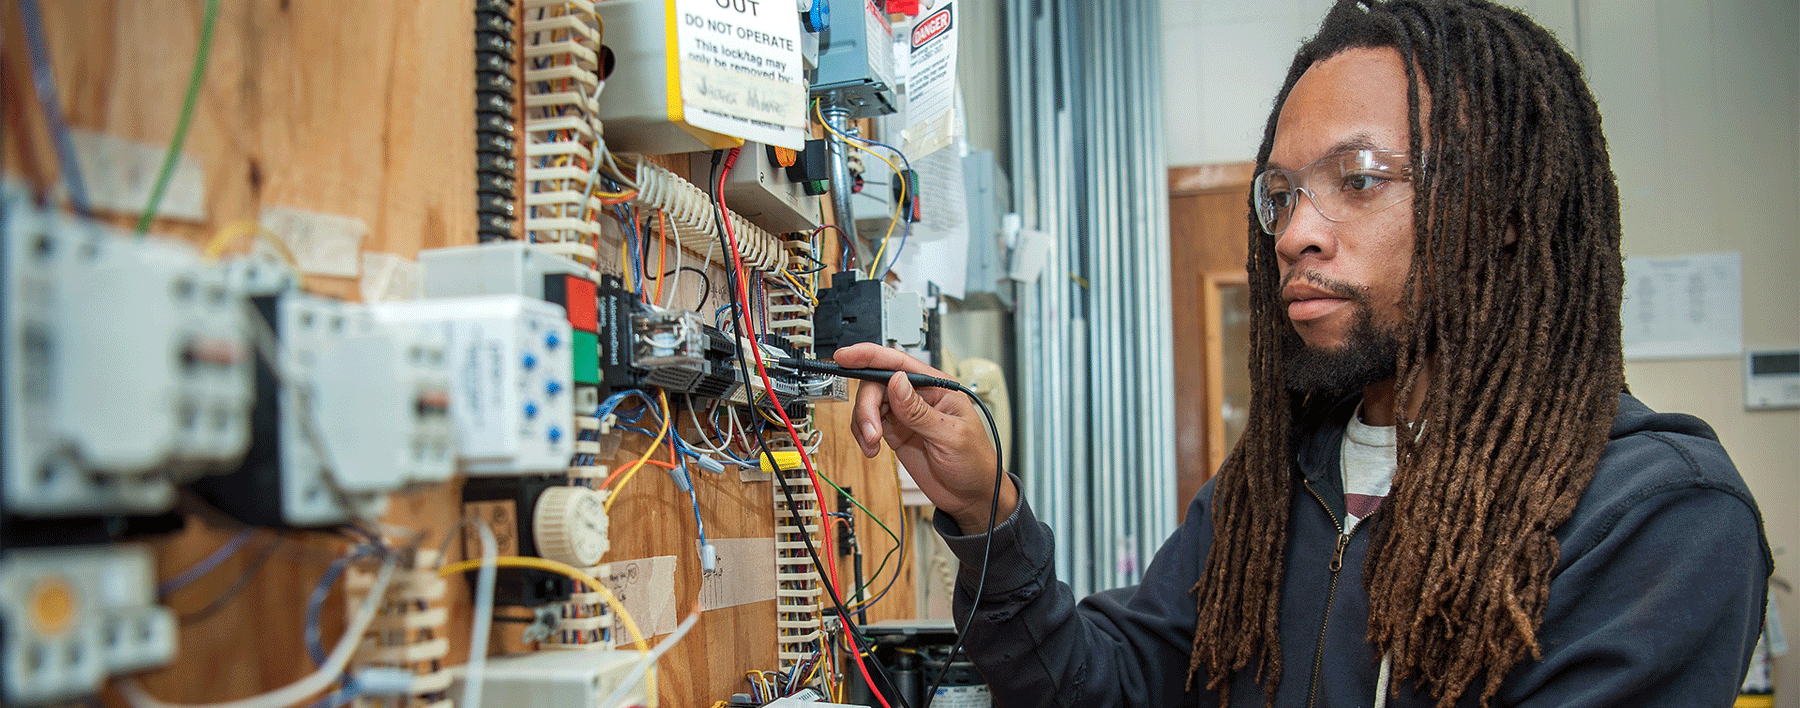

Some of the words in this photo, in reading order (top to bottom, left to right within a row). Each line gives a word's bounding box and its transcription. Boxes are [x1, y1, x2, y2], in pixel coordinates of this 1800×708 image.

[685, 13, 704, 28] DO
[708, 19, 732, 35] NOT
[737, 27, 794, 52] OPERATE
[914, 14, 948, 44] DANGER
[689, 52, 711, 66] only
[714, 57, 727, 69] be
[730, 63, 775, 80] removed
[695, 37, 718, 53] This
[721, 45, 763, 67] lock/tag
[766, 58, 786, 72] may
